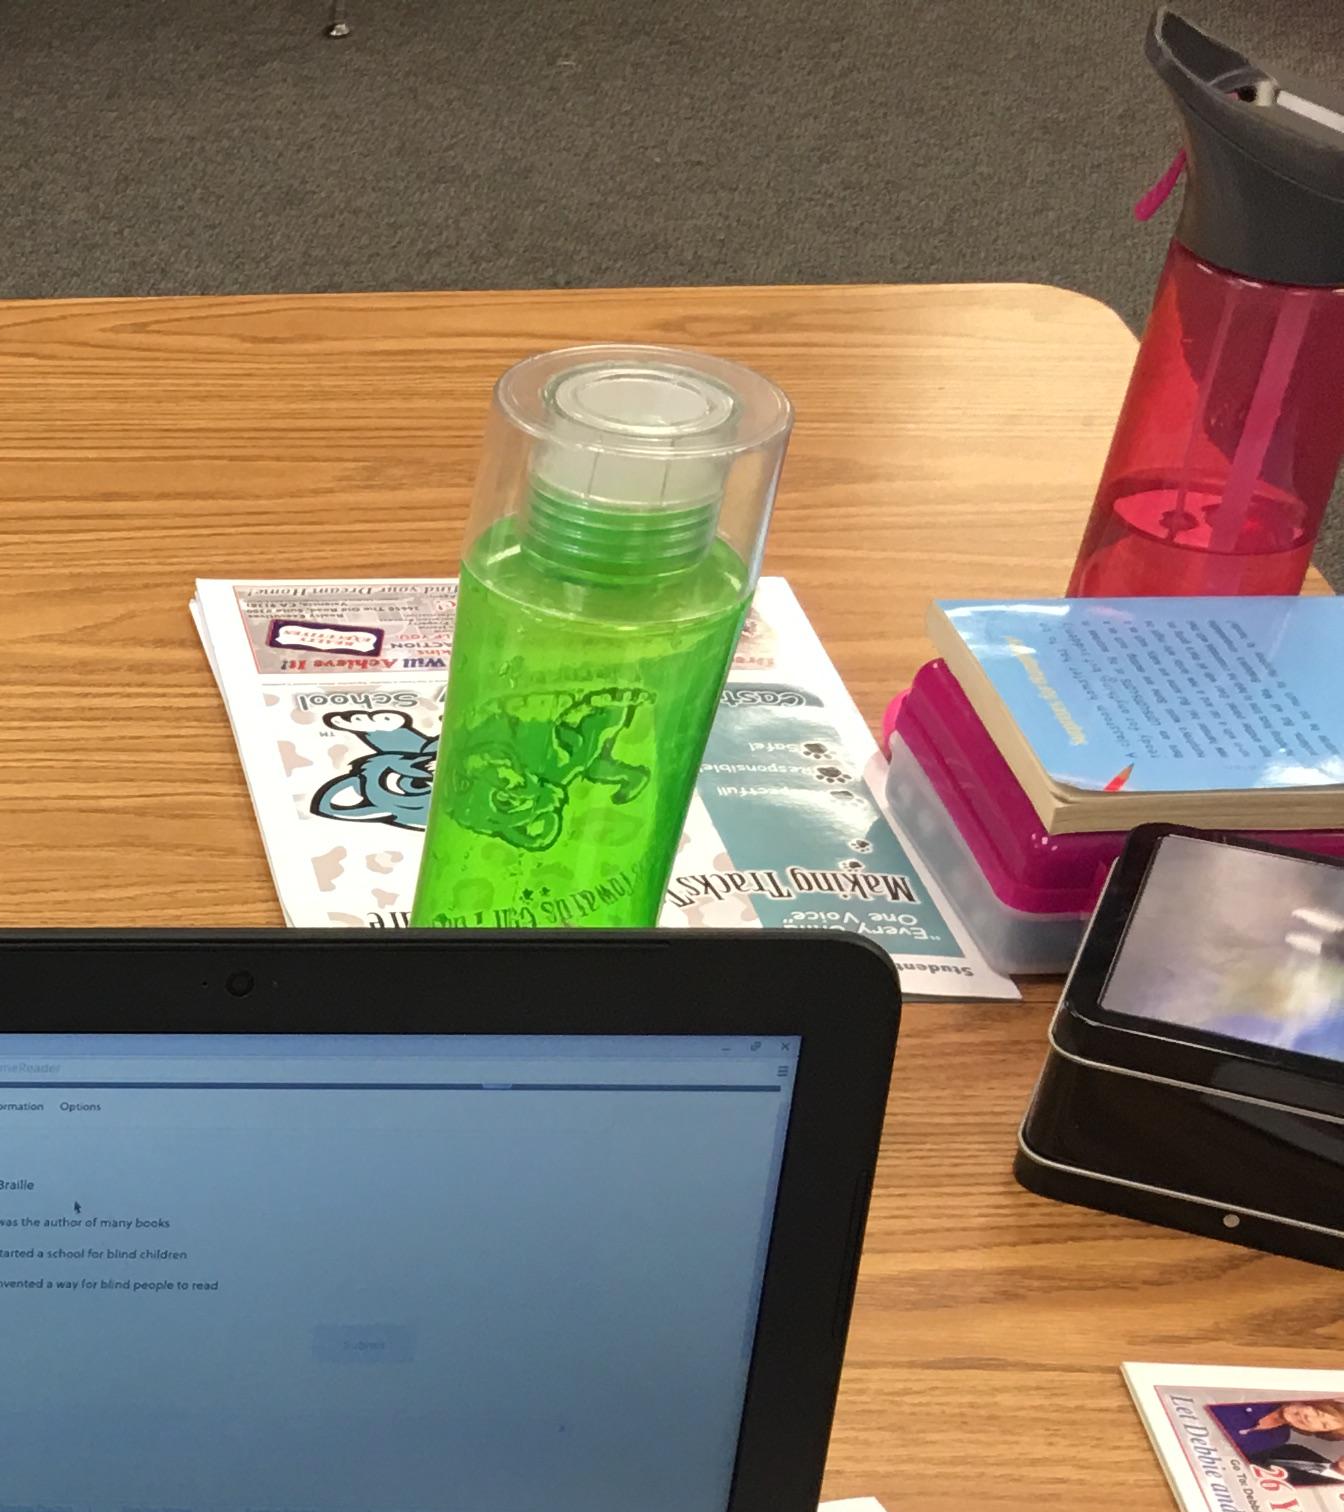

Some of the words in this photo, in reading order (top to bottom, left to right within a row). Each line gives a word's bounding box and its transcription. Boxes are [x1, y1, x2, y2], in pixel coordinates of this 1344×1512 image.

[280, 659, 306, 670] It!
[313, 658, 398, 670] Achieve
[403, 658, 446, 668] Will
[297, 693, 418, 711] School
[787, 867, 916, 903] Making
[868, 912, 918, 926] One
[59, 1101, 102, 1113] Options
[22, 1217, 40, 1227] the
[44, 1217, 82, 1227] author
[84, 1217, 97, 1227] of
[100, 1219, 132, 1229] many
[136, 1218, 170, 1228] books
[37, 1250, 43, 1258] a
[47, 1248, 84, 1259] school
[87, 1249, 104, 1259] for
[107, 1249, 137, 1260] blind
[140, 1249, 188, 1260] children
[46, 1280, 53, 1289] a
[56, 1280, 78, 1291] way
[81, 1278, 97, 1289] for
[100, 1279, 130, 1290] blind
[133, 1280, 174, 1293] people
[177, 1280, 189, 1290] to
[192, 1279, 218, 1291] read
[1170, 1395, 1196, 1423] Let
[1182, 1424, 1225, 1479] Debbie
[1228, 1458, 1242, 1473] Go
[1249, 1464, 1289, 1493] 26
